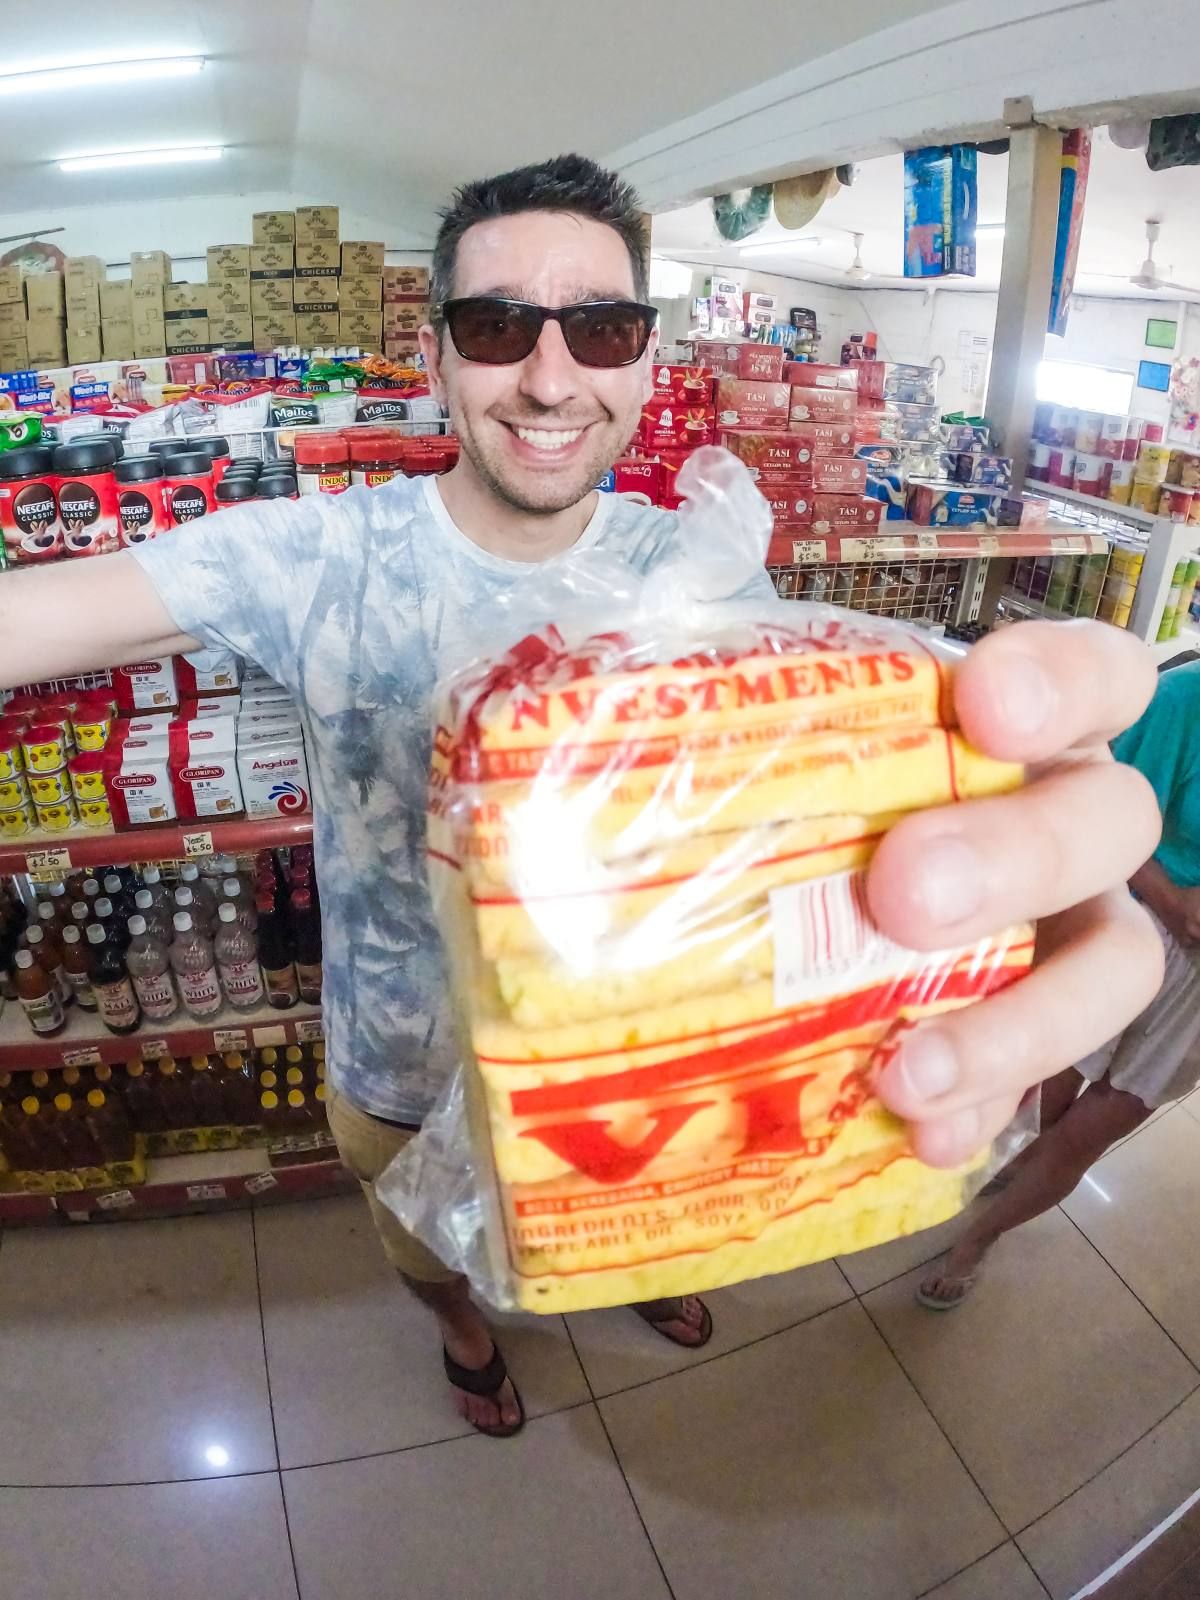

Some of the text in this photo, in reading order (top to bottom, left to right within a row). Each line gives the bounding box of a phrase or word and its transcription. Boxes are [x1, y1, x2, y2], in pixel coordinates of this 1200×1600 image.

[301, 268, 336, 277] CHICKEN
[299, 303, 333, 312] CHICKEN
[171, 346, 206, 354] CHICKEN
[746, 392, 766, 401] TASI
[274, 406, 313, 421] MaiTos
[363, 403, 401, 418] MaiTos
[815, 429, 833, 437] TASI
[768, 448, 790, 458] TASI
[824, 464, 843, 473] TASI
[175, 506, 202, 514] CLASSIC
[840, 507, 858, 516] TASI
[21, 511, 54, 522] CLASSIC
[186, 769, 220, 778] GLORIPAN
[118, 776, 152, 785] GLORIPAN
